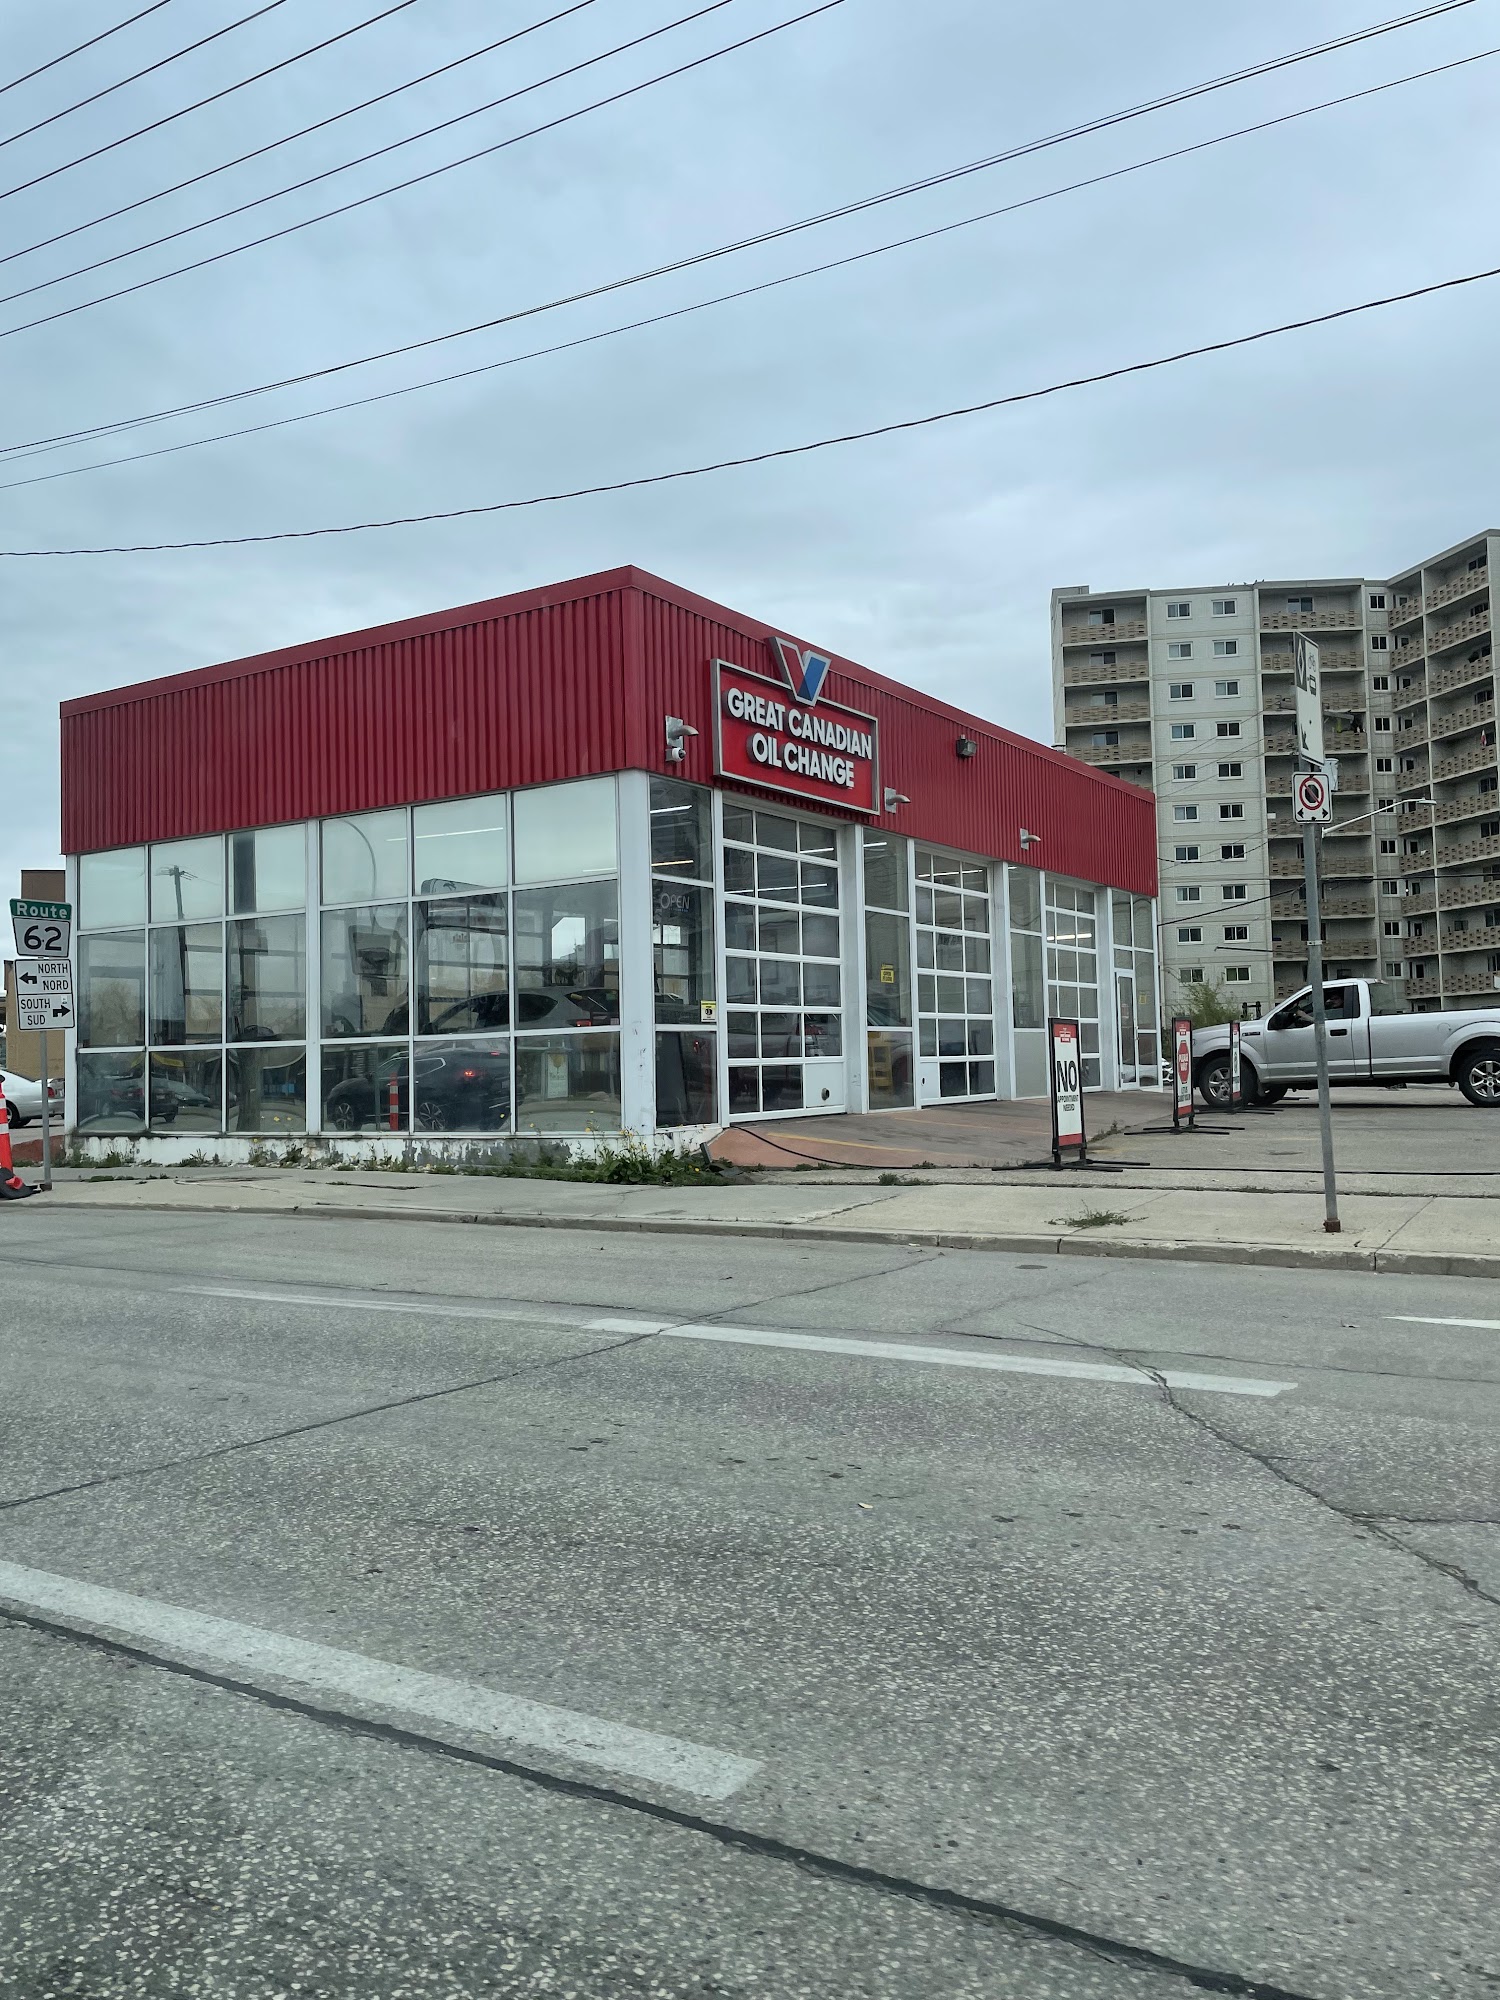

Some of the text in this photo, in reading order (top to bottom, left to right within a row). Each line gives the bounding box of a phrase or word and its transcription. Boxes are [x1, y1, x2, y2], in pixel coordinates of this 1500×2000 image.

[727, 687, 873, 760] GREAT CANADIAN
[752, 732, 855, 788] OIL CHANGE
[660, 893, 690, 909] OPEN
[16, 901, 68, 919] Route
[23, 924, 62, 951] 62
[38, 963, 69, 974] NORTH
[43, 980, 69, 991] NORD
[20, 998, 51, 1010] SOUTH
[27, 1014, 46, 1026] SUD
[1056, 1060, 1078, 1092] NO
